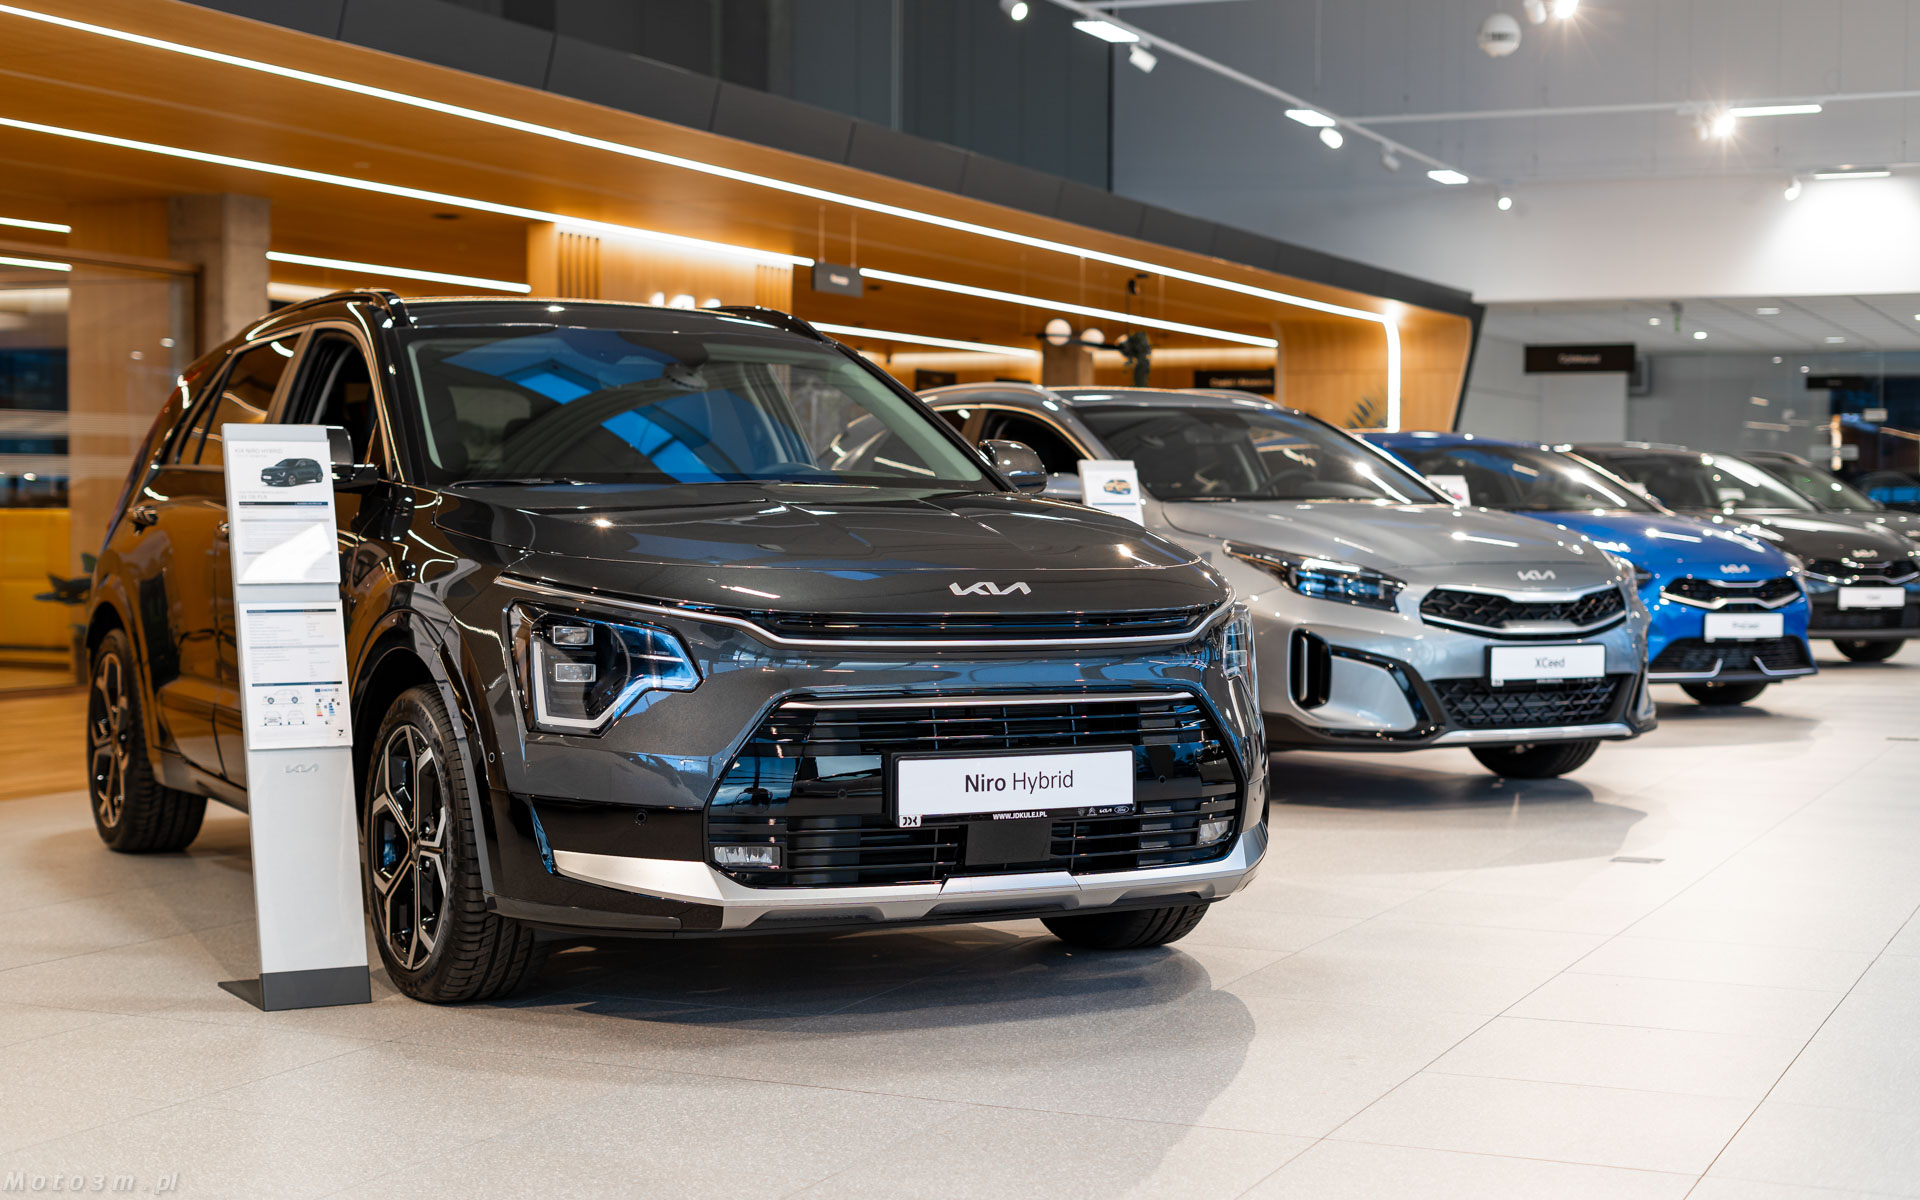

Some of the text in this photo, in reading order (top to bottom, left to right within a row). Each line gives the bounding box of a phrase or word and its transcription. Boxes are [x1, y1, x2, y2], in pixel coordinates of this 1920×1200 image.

[949, 581, 1032, 596] KIA
[1535, 657, 1566, 668] XCeed
[965, 769, 1073, 795] Niro Hybrid
